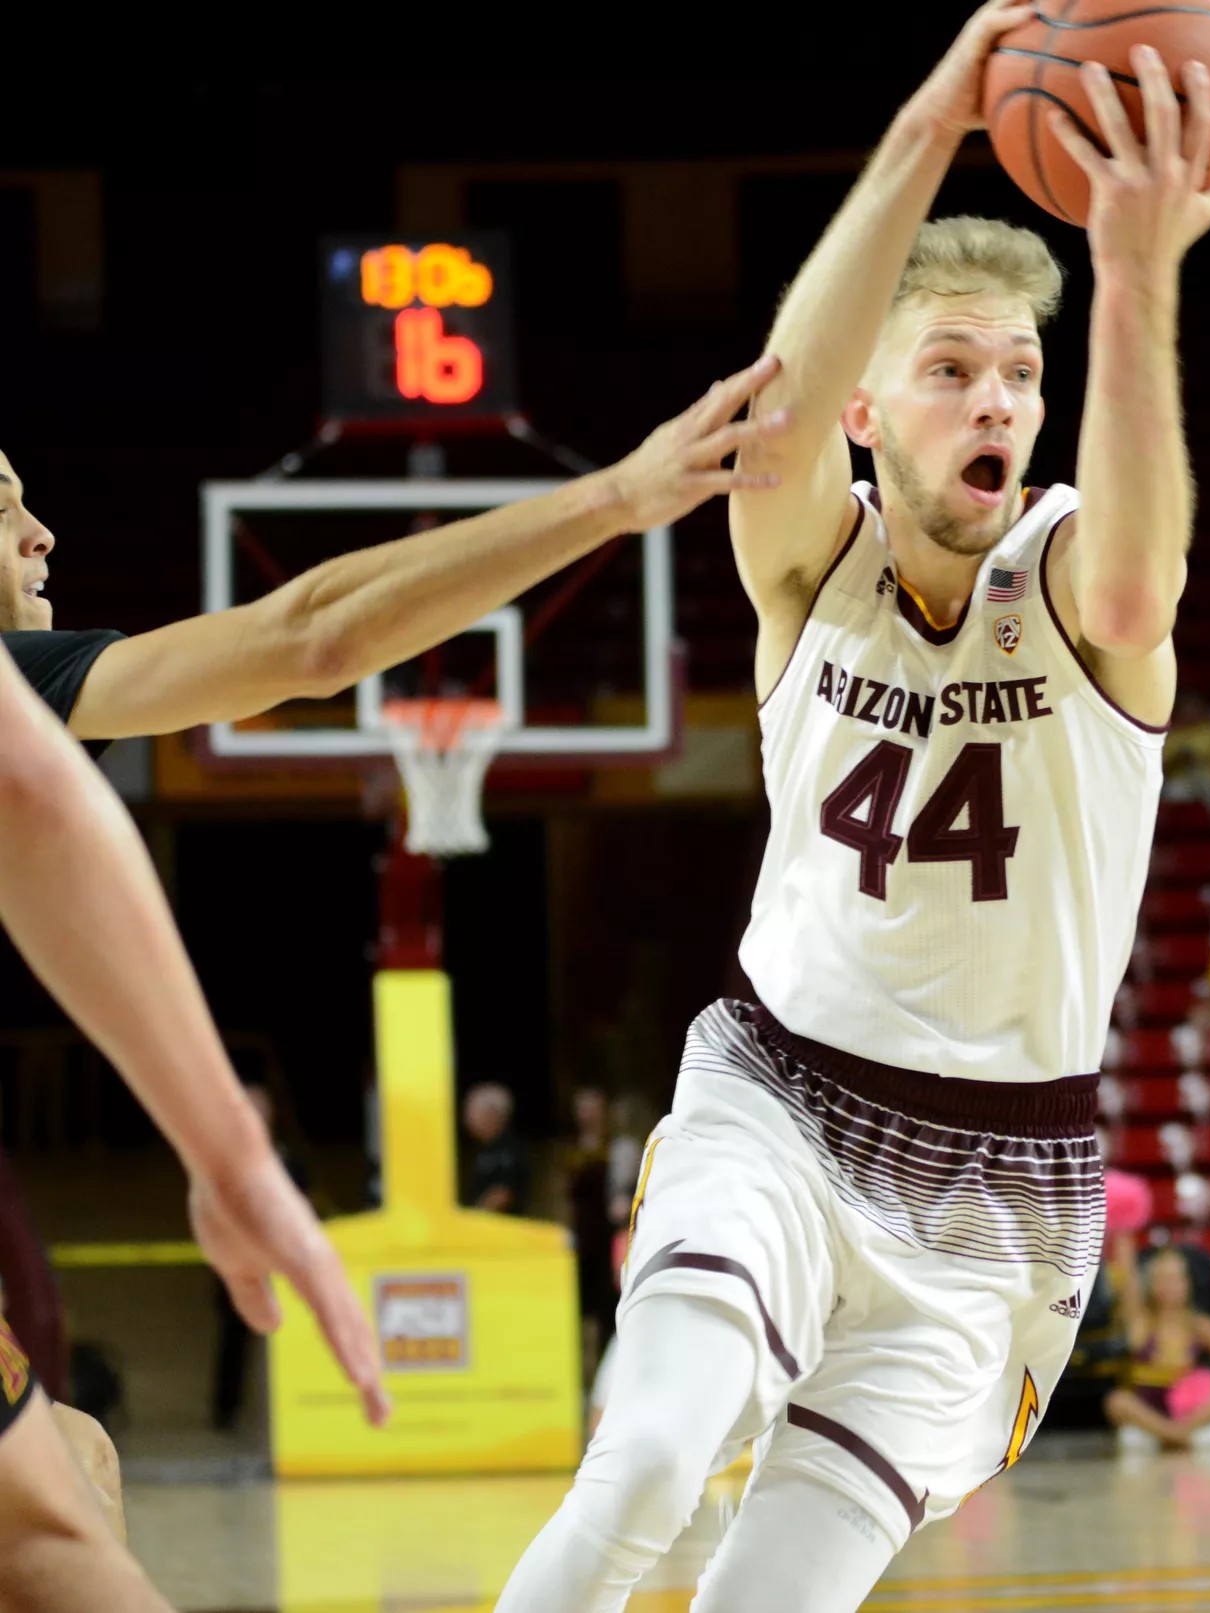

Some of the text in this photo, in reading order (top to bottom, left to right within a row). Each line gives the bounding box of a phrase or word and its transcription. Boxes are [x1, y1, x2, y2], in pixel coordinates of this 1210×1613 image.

[395, 306, 483, 404] 16
[939, 676, 1053, 726] STATE
[820, 739, 1020, 902] 44
